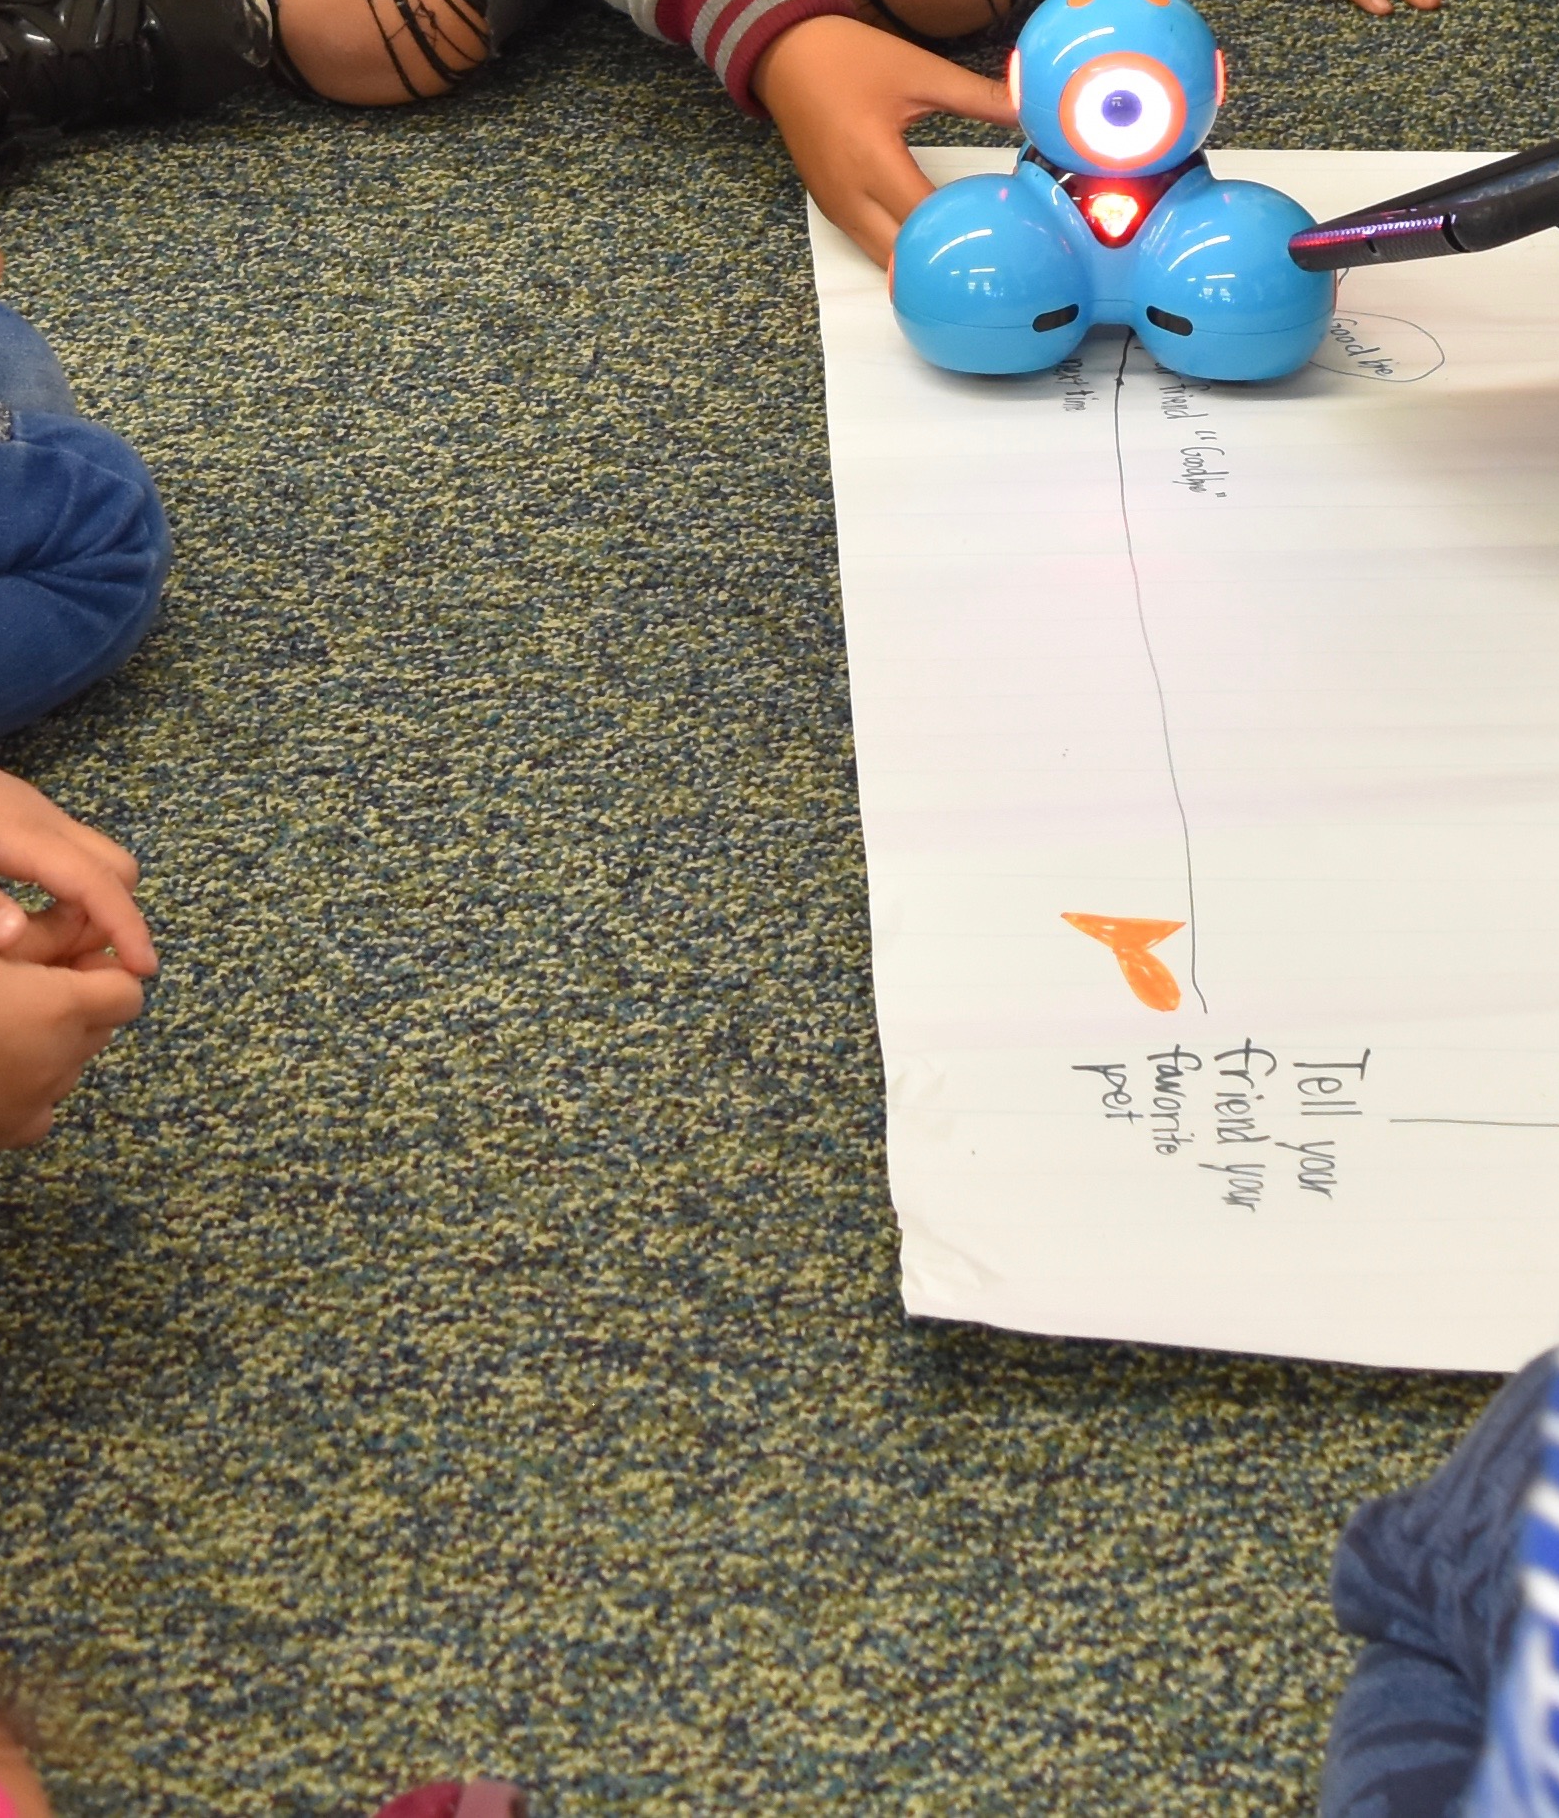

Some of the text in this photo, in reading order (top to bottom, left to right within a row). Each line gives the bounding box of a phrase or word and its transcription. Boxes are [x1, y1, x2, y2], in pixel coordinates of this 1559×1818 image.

[1158, 383, 1212, 420] friend
[1071, 1063, 1145, 1125] pet
[1146, 1044, 1203, 1156] favorite
[1198, 1037, 1278, 1213] friend your
[1275, 1047, 1372, 1200] Tell your
